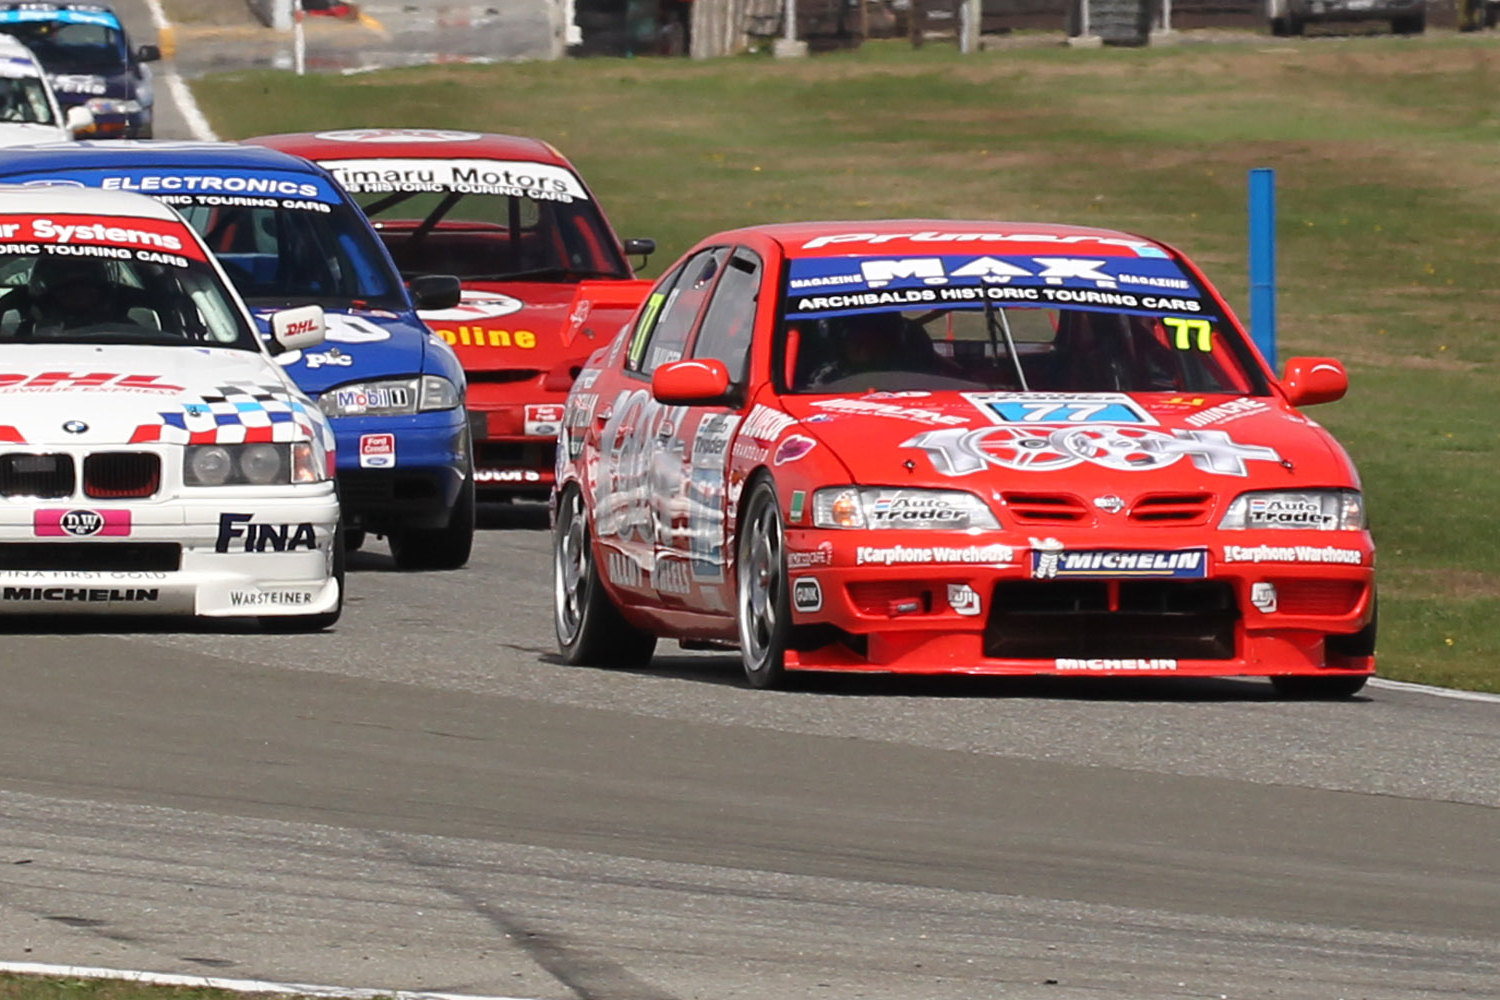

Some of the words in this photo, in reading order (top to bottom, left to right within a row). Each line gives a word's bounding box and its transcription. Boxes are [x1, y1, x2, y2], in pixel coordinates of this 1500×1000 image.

[102, 176, 318, 197] ELECTRONICS
[328, 166, 434, 183] Timaru
[452, 166, 568, 193] Motors
[365, 182, 443, 194] HISTORIC
[449, 183, 524, 198] TOURING
[527, 189, 575, 204] CARS
[196, 196, 279, 208] TOURING
[282, 200, 332, 213] CARS
[32, 219, 182, 251] Systems
[44, 244, 132, 260] TOURING
[137, 251, 190, 268] CARS
[790, 273, 863, 289] MAGAZINE
[861, 256, 1117, 281] MAX
[1118, 273, 1190, 290] MAGAZINE
[798, 289, 936, 311] ARCHIBALDS
[941, 286, 1039, 300] HISTORIC
[1042, 288, 1138, 307] TOURING
[1142, 296, 1202, 312] CARS
[283, 319, 319, 337] DHL
[435, 326, 537, 348] oline
[1163, 317, 1213, 352] 77
[337, 387, 390, 409] Mobil
[1021, 403, 1107, 422] 77
[890, 497, 950, 509] Auto
[1265, 501, 1318, 512] Auto
[873, 508, 967, 522] Trader
[1251, 511, 1333, 524] Trader
[215, 513, 317, 553] FINA
[864, 544, 933, 566] Carphone
[933, 545, 1014, 564] Warehouse
[1064, 551, 1201, 570] MICHELIN
[1233, 545, 1298, 563] Carphone
[1298, 546, 1362, 565] Warehouse
[2, 587, 159, 602] MICHELIN
[230, 591, 312, 606] WARSTEINER
[1055, 658, 1178, 671] MICHELIN
